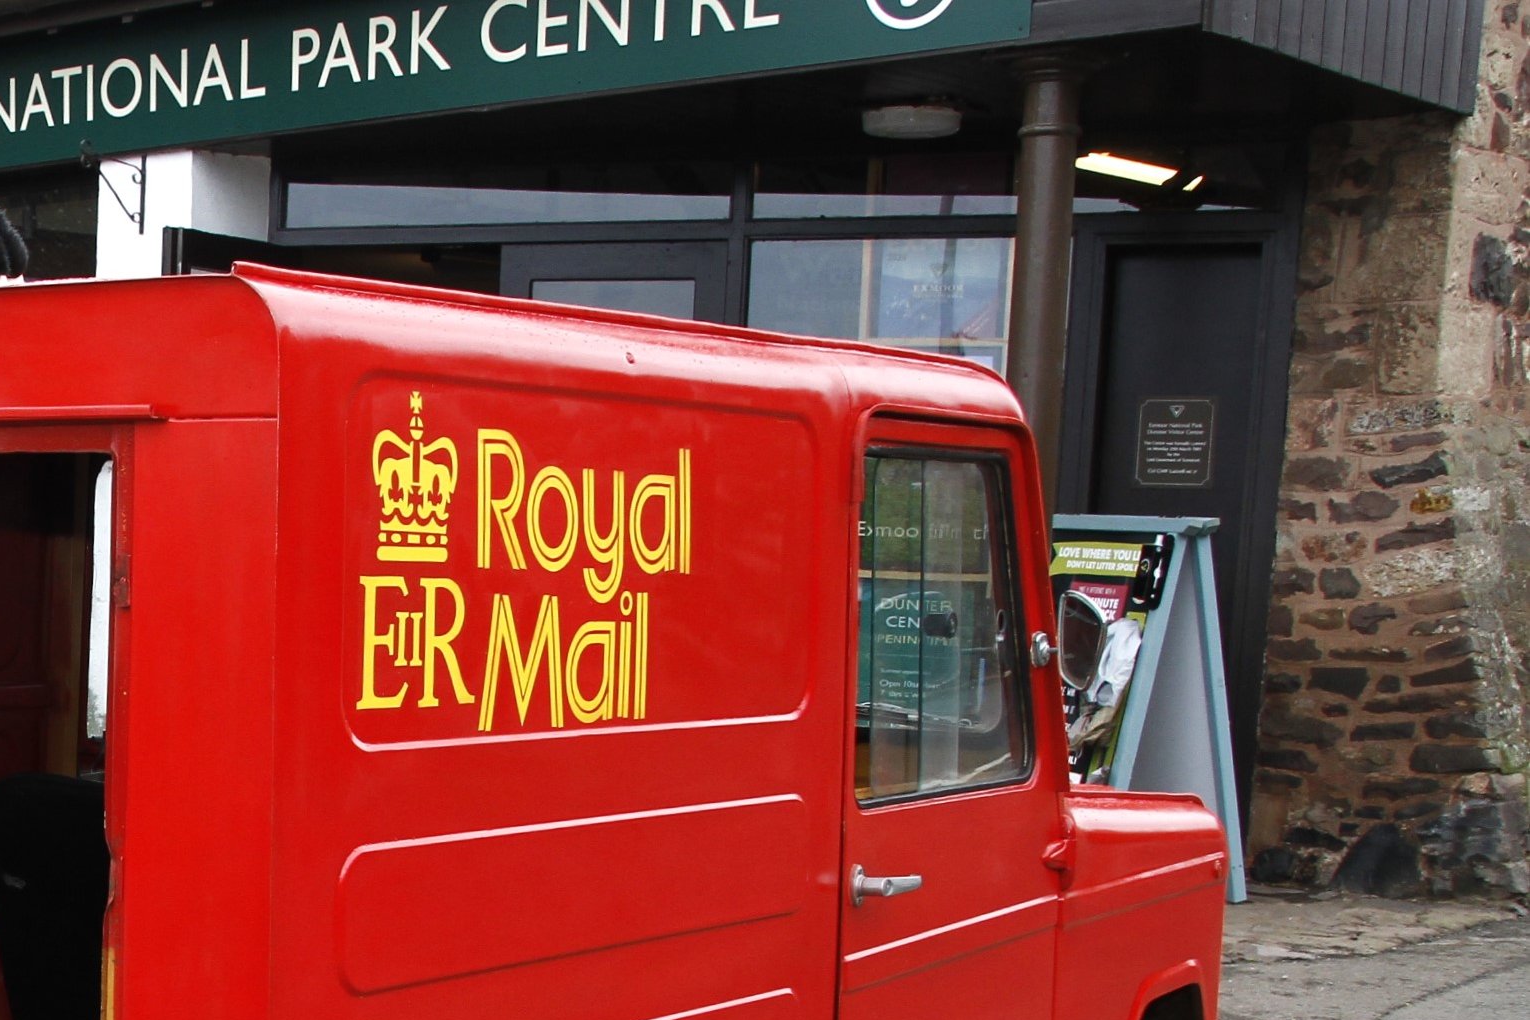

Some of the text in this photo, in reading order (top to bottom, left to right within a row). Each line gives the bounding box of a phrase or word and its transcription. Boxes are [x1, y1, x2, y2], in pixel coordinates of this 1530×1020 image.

[291, 4, 451, 92] PARK
[476, 428, 691, 604] Royal
[1059, 547, 1082, 559] LOVE
[1082, 548, 1113, 560] WHERE
[1113, 549, 1132, 561] YOU
[1086, 561, 1096, 569] LET
[1096, 562, 1116, 570] LITTER
[477, 590, 648, 732] Mail
